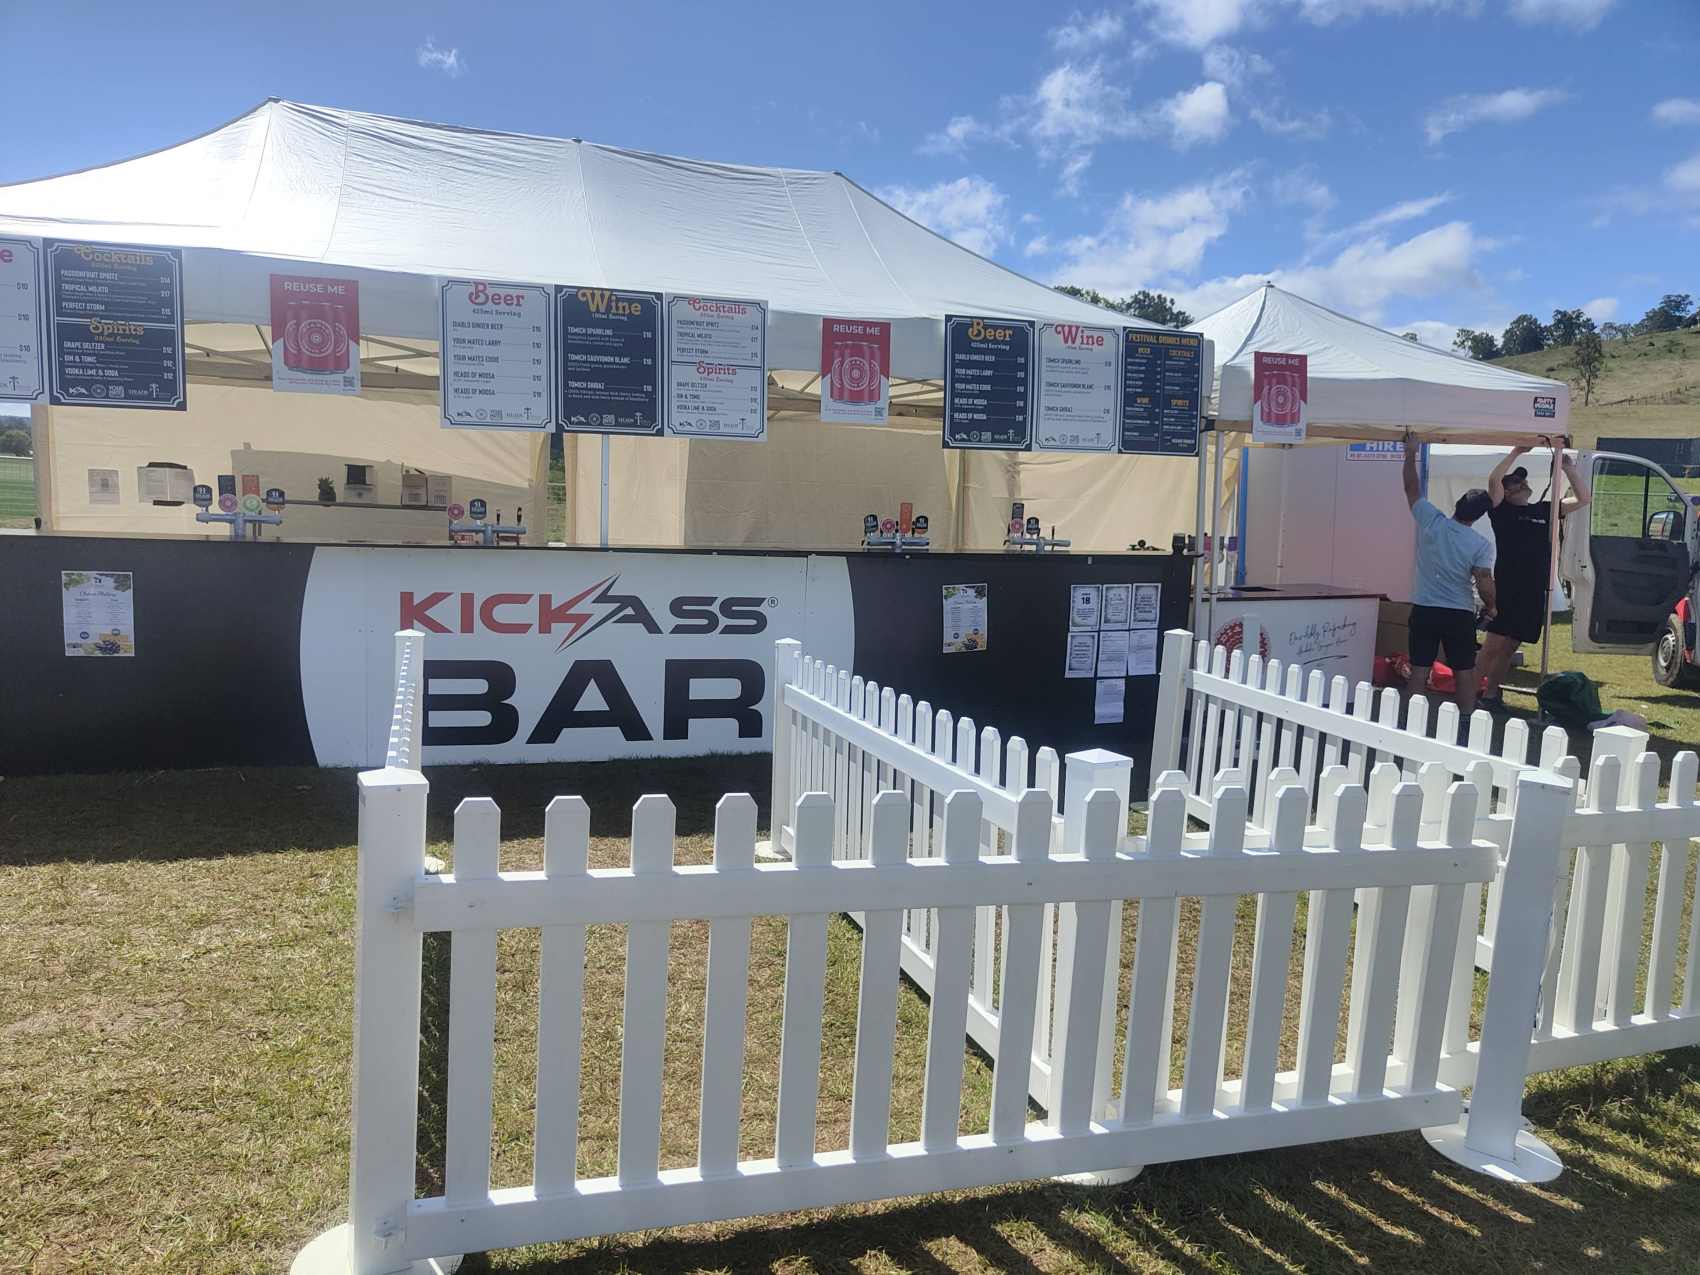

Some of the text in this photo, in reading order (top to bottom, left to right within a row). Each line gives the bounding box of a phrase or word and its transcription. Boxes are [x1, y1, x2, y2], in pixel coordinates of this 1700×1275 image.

[73, 245, 154, 265] Cocktails
[114, 262, 138, 272] Serving
[60, 270, 98, 279] PASSIONFRUIT
[99, 272, 118, 280] SPRITZ
[17, 282, 28, 290] $10
[61, 284, 87, 292] TROPICAL
[88, 285, 108, 293] MOJITO
[161, 290, 170, 298] $17
[284, 282, 346, 295] REUSE ME
[468, 281, 525, 307] Beer
[62, 301, 85, 310] PERFECT
[86, 303, 105, 311] STORM
[577, 289, 642, 316] Wine
[687, 298, 747, 314] Cocktails
[18, 313, 29, 321] $10
[494, 309, 522, 318] Serving
[89, 317, 144, 335] Spirits
[471, 322, 489, 330] GINGER
[490, 323, 504, 331] BEER
[676, 319, 705, 327] PASSIONFRUIT
[567, 326, 586, 334] TOMICH
[586, 328, 613, 336] SPARKLING
[833, 324, 880, 335] REUSE ME
[968, 318, 1013, 341] Beer
[116, 336, 140, 344] Serving
[677, 331, 696, 339] TROPICAL
[1054, 324, 1104, 346] Wine
[1128, 333, 1198, 346] FESTIVAL DRINKS MENU
[63, 341, 81, 349] GRAPE
[82, 342, 105, 350] SELTZER
[988, 343, 1010, 351] Serving
[1169, 349, 1194, 357] COCKTAILS
[64, 354, 74, 362] GIN
[81, 355, 97, 363] TONIC
[467, 355, 484, 363] MATES
[587, 355, 614, 363] SAUVIGNON
[614, 356, 631, 364] BLANC
[1262, 356, 1300, 366] REUSE ME
[84, 368, 97, 376] LIME
[696, 361, 737, 376] Spirits
[471, 371, 478, 379] OF
[453, 387, 470, 395] HEADS
[1366, 441, 1404, 451] HIRE
[1081, 596, 1091, 605] 18
[422, 659, 765, 746] BAR
